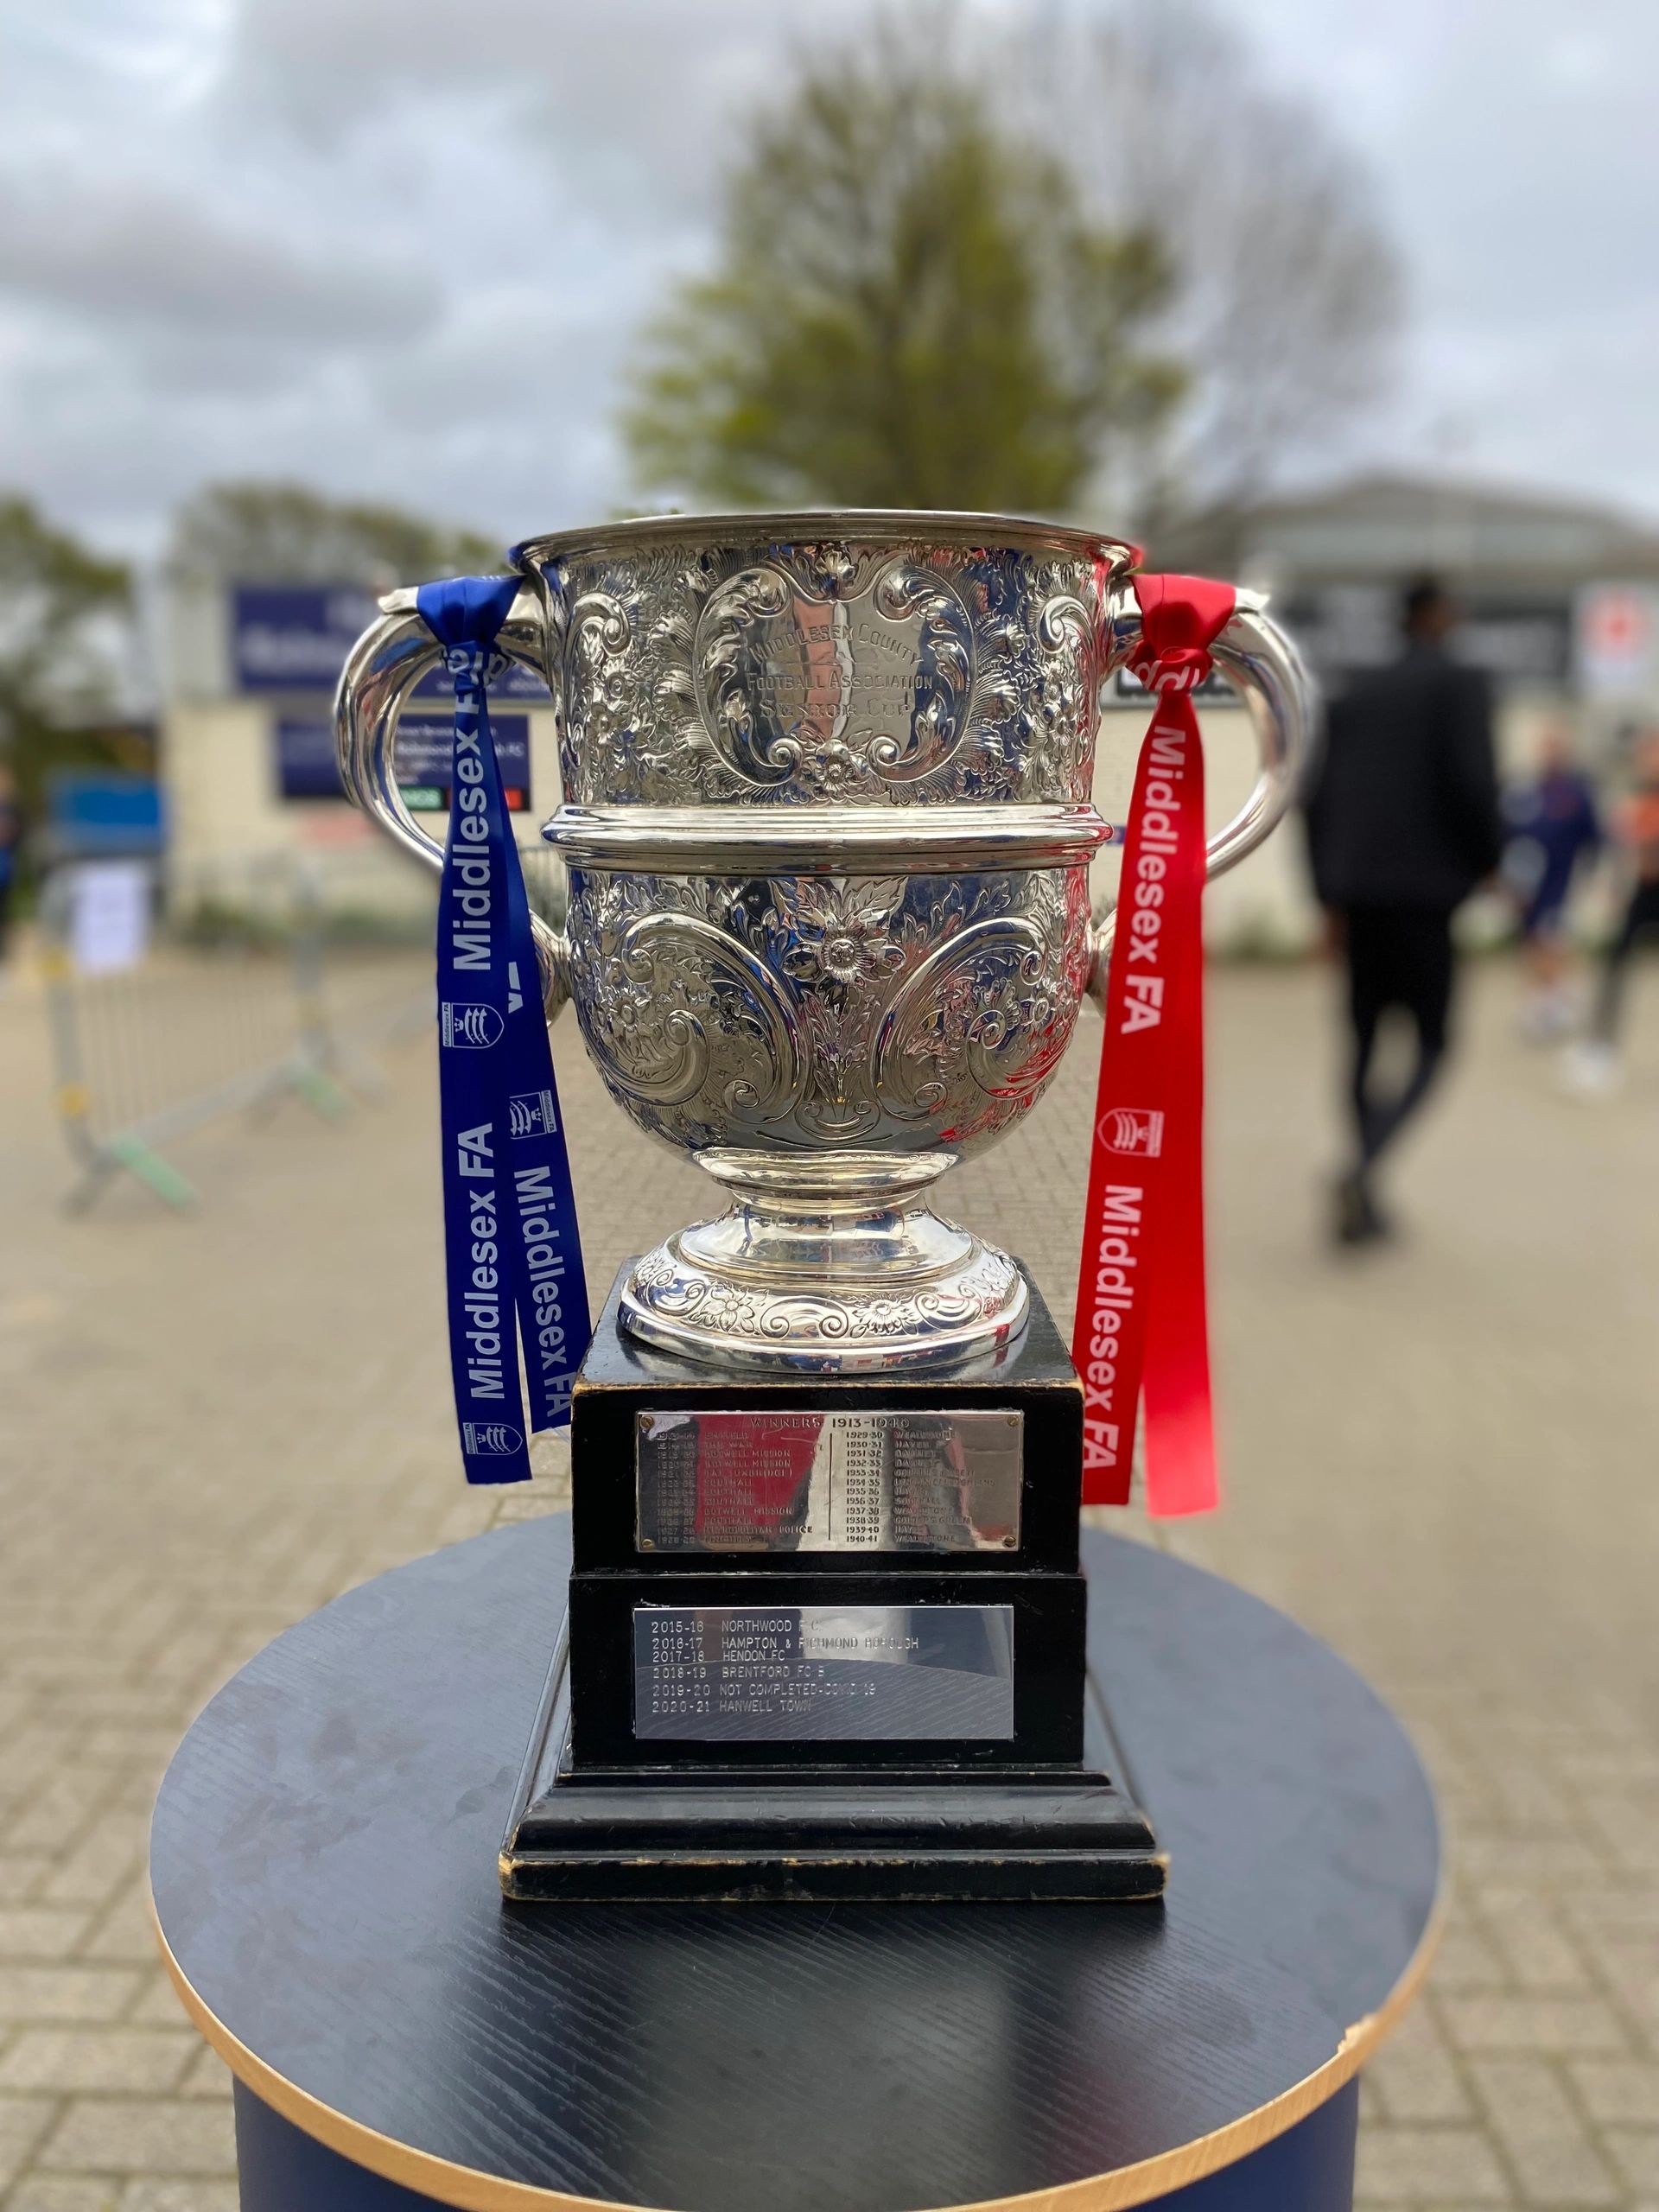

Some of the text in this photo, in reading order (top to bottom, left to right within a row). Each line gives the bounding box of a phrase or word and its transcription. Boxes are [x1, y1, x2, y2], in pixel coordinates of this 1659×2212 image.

[749, 622, 924, 667] MIDDLESEX COUNTY
[747, 671, 933, 690] FOOTBALL ASSOCIATION
[760, 697, 910, 718] SENIOR CUP
[452, 728, 492, 971] Middlesex
[1127, 724, 1187, 964] Middlesex
[1121, 975, 1166, 1035] FA
[458, 1122, 505, 1400] Middlesex FA
[513, 1166, 576, 1418] Middlesex FA
[1084, 1185, 1143, 1469] Middlesex FA
[751, 1417, 910, 1428] WINNERS 1913-1940
[779, 1526, 813, 1535] POLICE
[651, 1621, 704, 1633] 2015-16
[721, 1620, 792, 1632] NORTHWOOD
[652, 1637, 703, 1649] 2016-17
[721, 1637, 778, 1649] HAMPTON
[785, 1638, 791, 1649] &
[798, 1637, 858, 1649] RICHMOND
[652, 1649, 785, 1662] 2017-18 HENDON FC
[653, 1667, 707, 1679] 2018-19
[721, 1666, 790, 1678] BRENTFORD
[797, 1666, 811, 1678] FC
[652, 1684, 710, 1697] 2019-20
[720, 1684, 741, 1696] NOT
[652, 1700, 811, 1713] 2020-21 HANWELL TOWN
